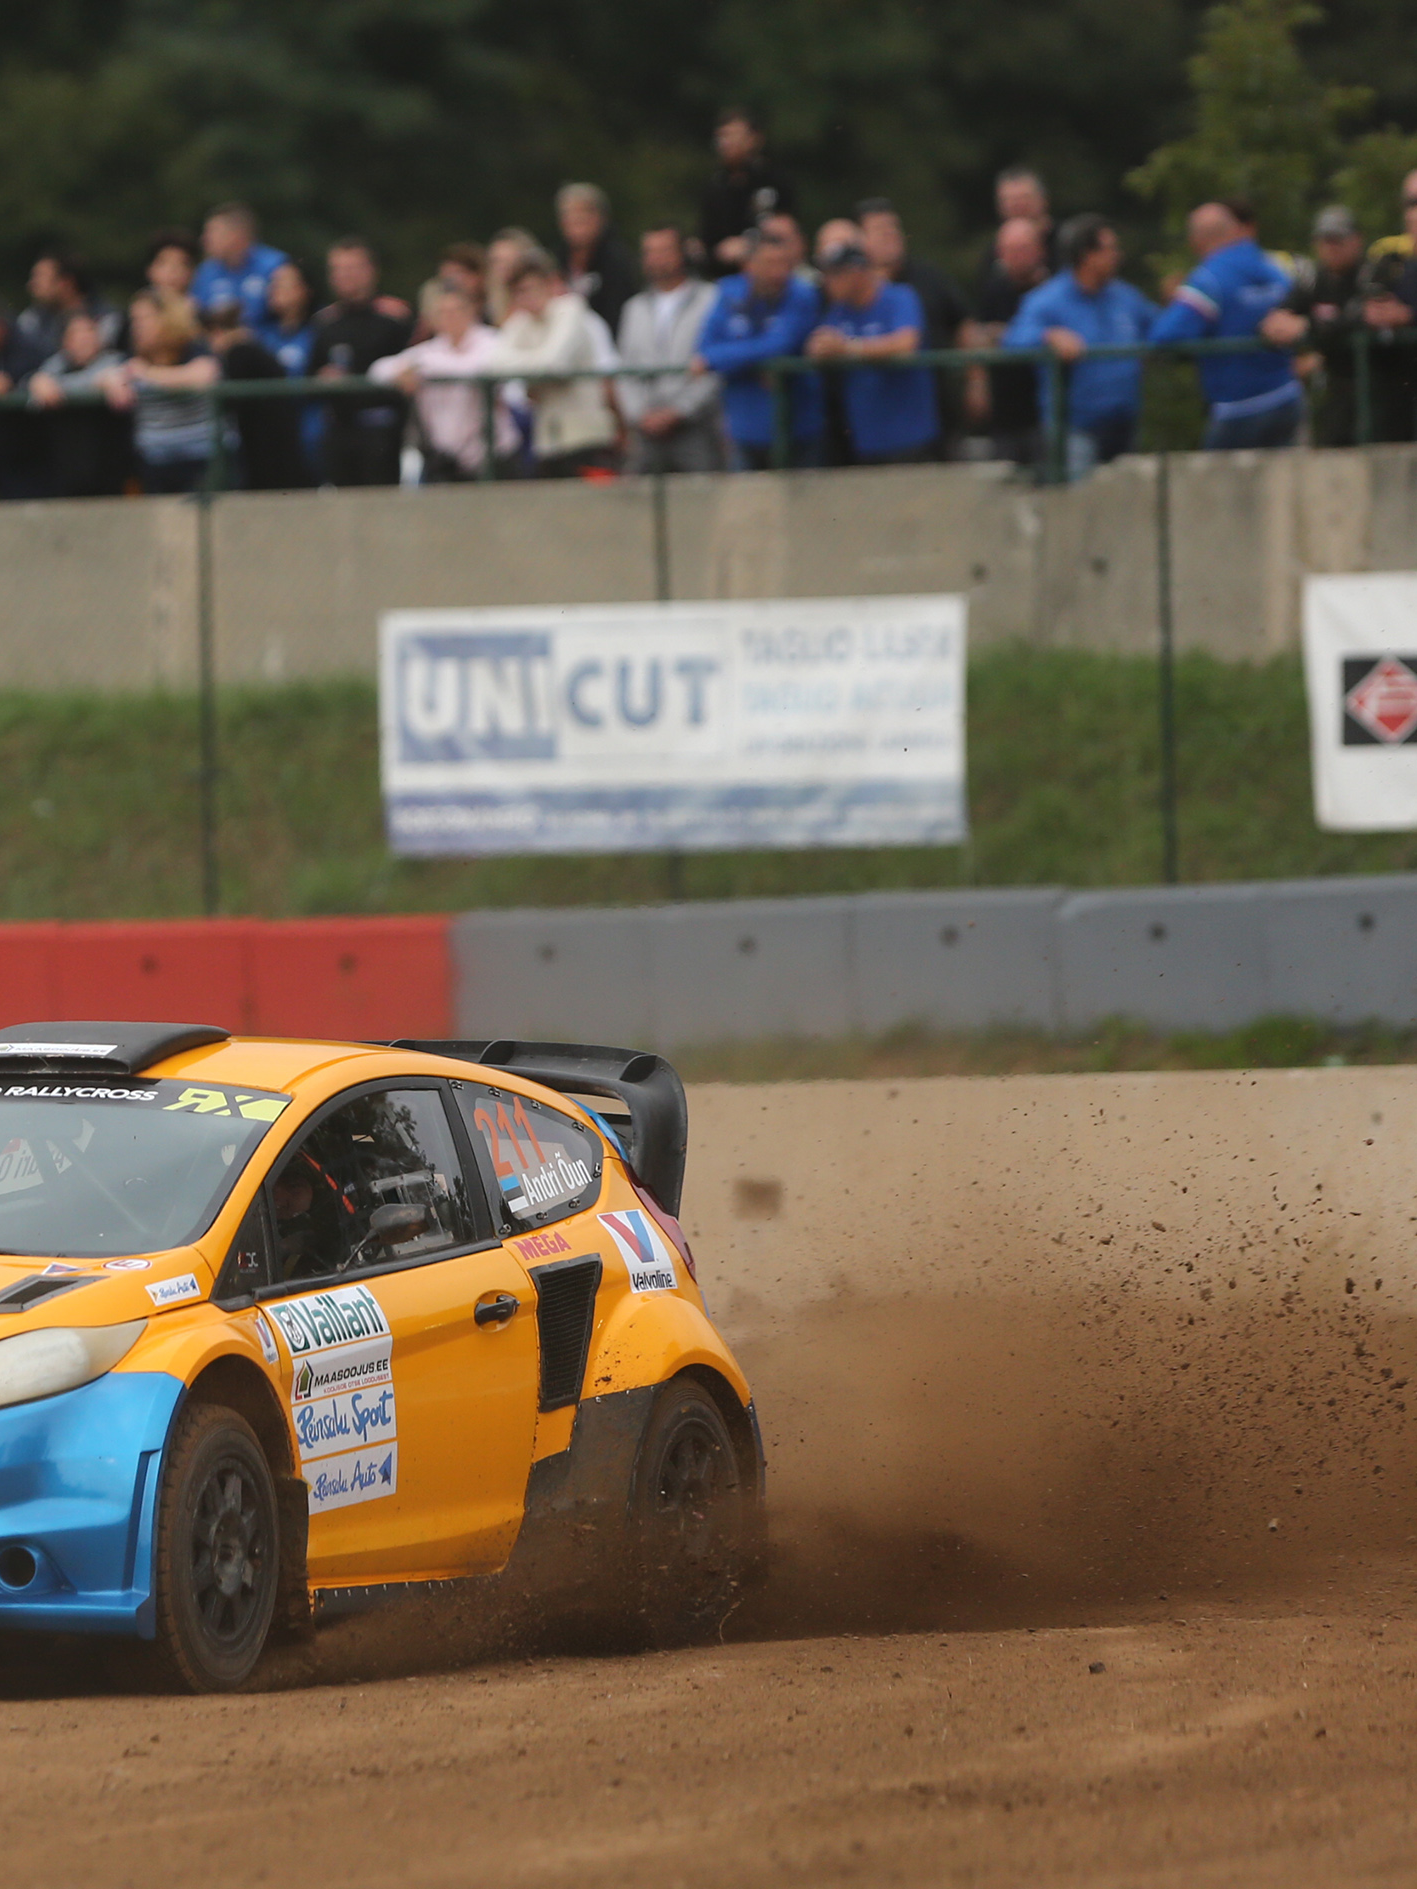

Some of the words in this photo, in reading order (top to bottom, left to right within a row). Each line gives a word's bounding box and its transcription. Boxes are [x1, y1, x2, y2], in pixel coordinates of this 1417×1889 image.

[4, 1086, 159, 1101] RALLYCROSS
[473, 1096, 547, 1178] 211
[522, 1162, 565, 1206] Andri
[555, 1151, 593, 1191] Õun
[513, 1231, 572, 1262] MEGA
[632, 1270, 673, 1291] Valvoline
[288, 1286, 384, 1347] Vaillant
[314, 1358, 389, 1389] MAASOOJUS.EE
[351, 1390, 394, 1443] Sport
[350, 1460, 378, 1492] Auto
